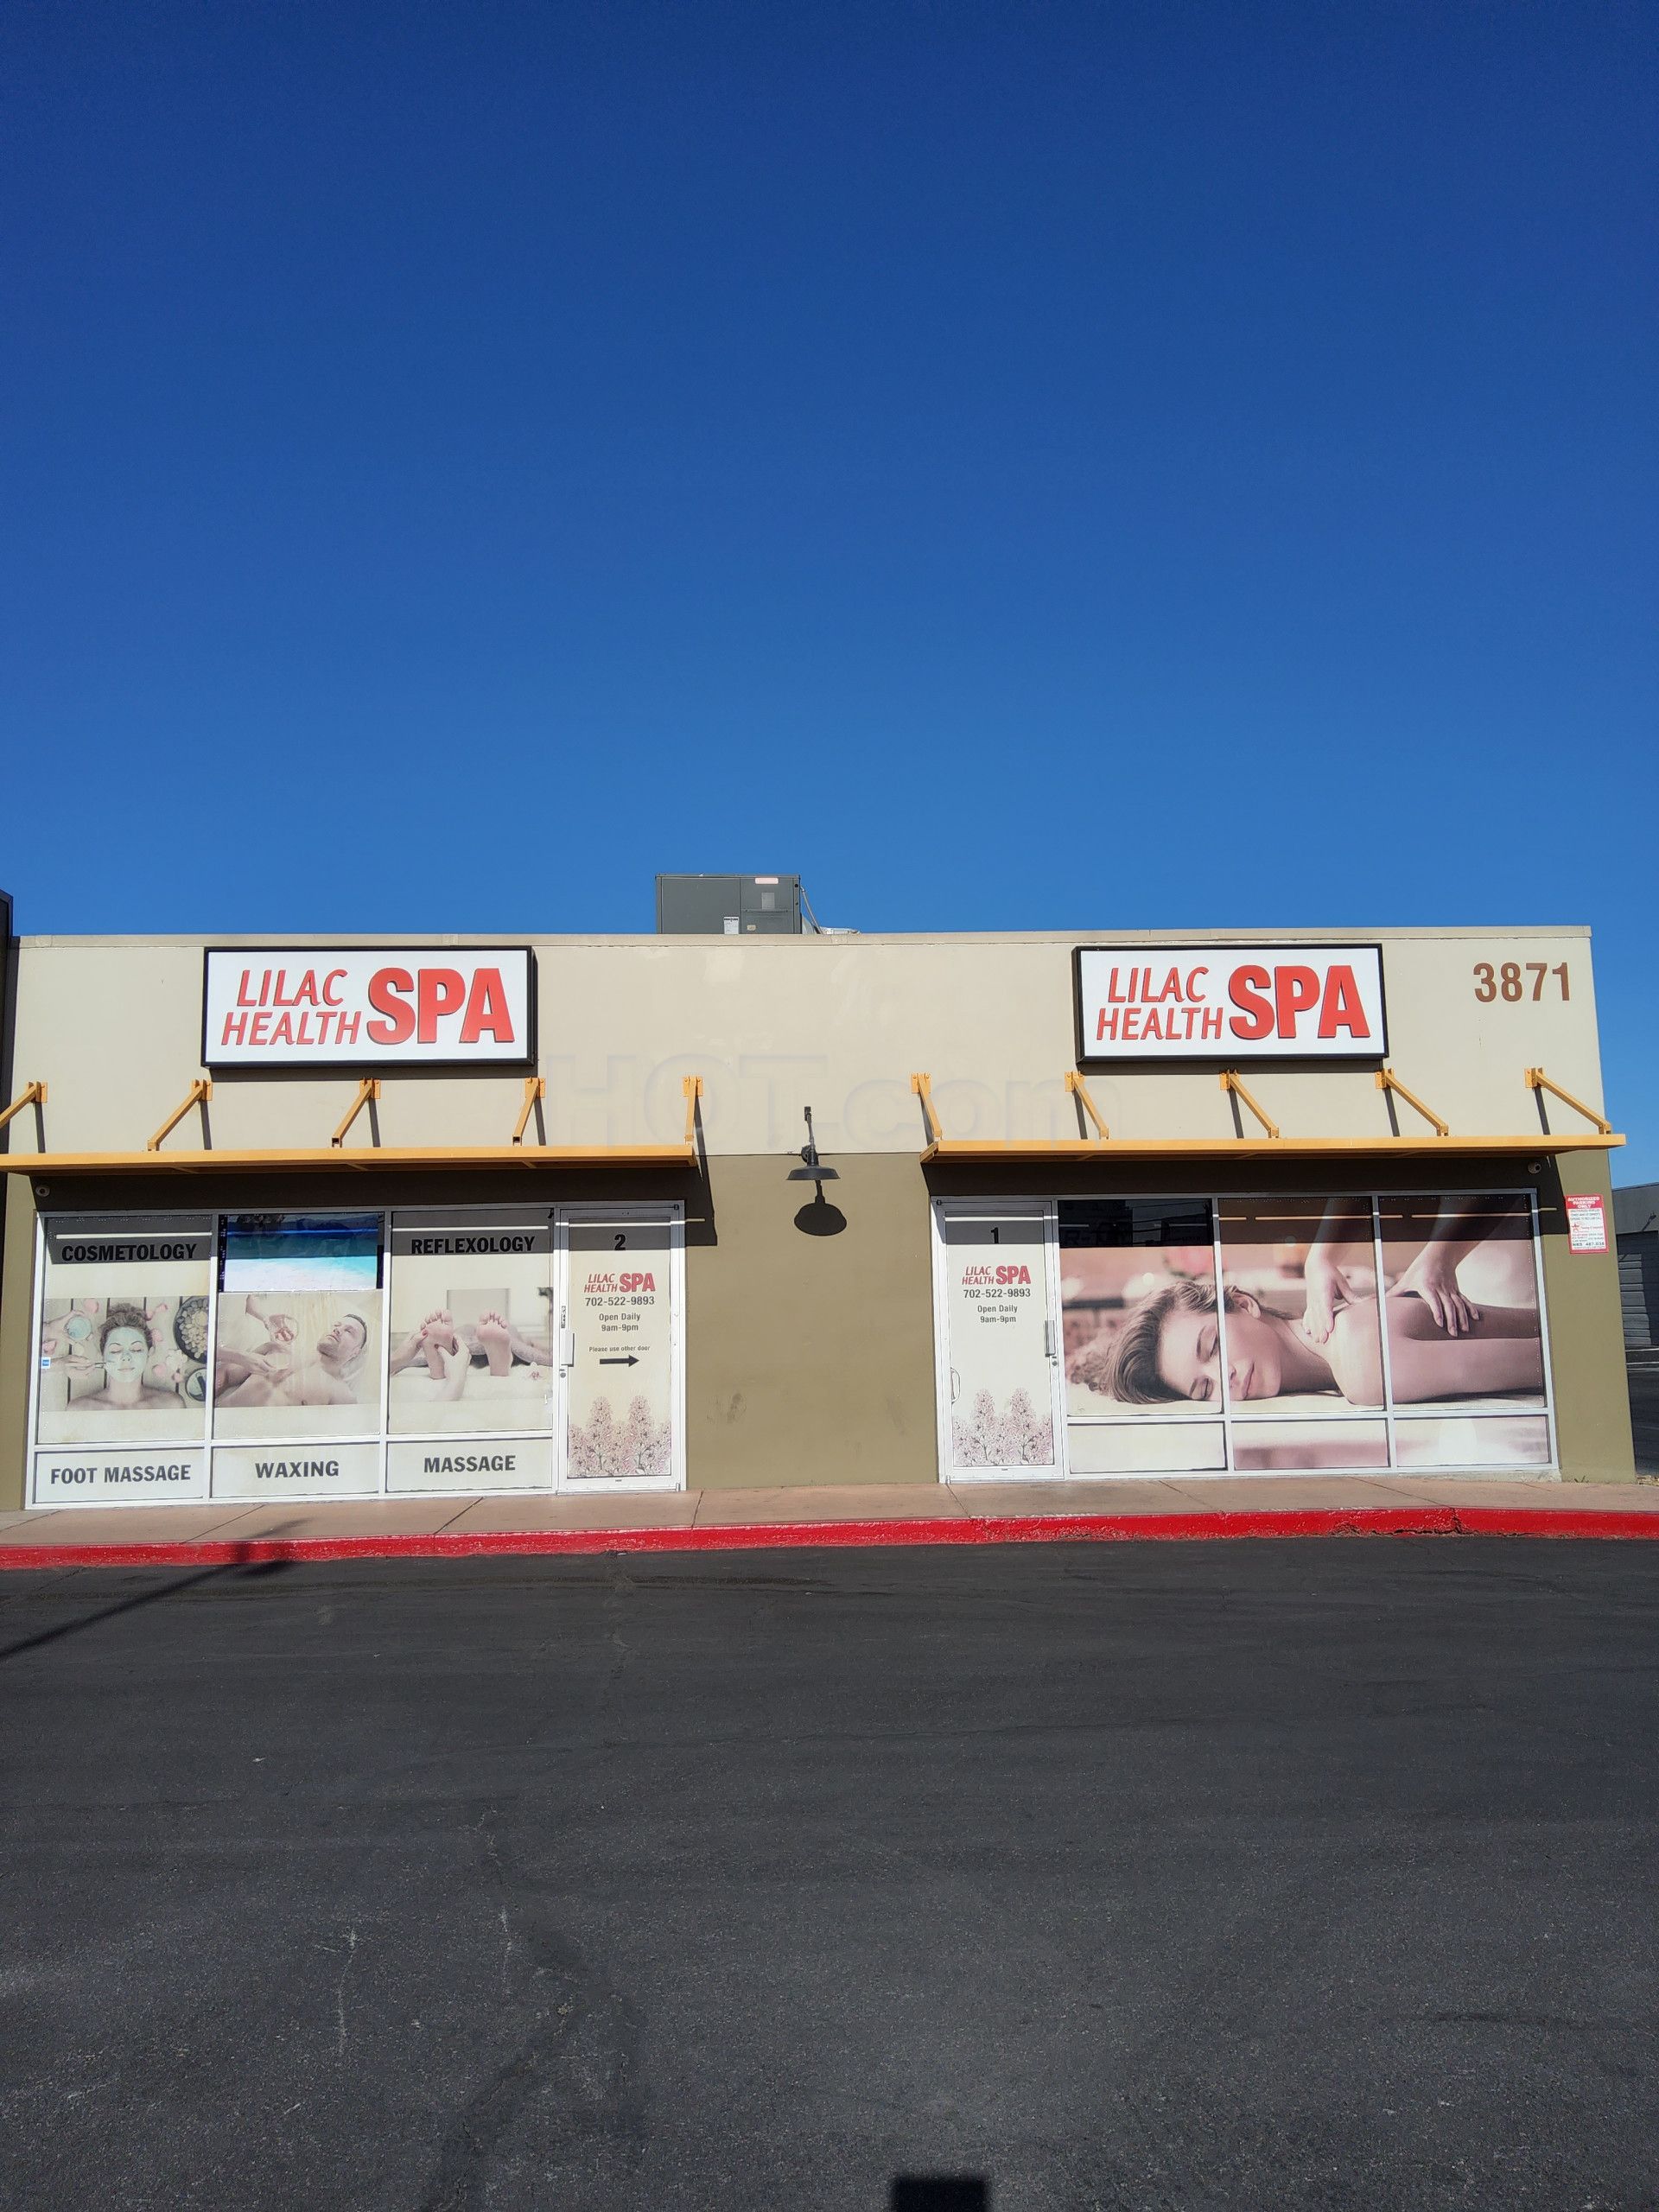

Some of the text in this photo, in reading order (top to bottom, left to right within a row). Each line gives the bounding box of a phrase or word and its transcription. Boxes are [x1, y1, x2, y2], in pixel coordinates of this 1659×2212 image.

[237, 969, 347, 1007] LILAC
[1108, 966, 1209, 1003] LILAC
[1473, 962, 1571, 1002] 3871
[367, 967, 515, 1044] SPA
[1229, 964, 1370, 1039] SPA
[221, 1011, 362, 1046] HEALTH
[1096, 1007, 1224, 1040] HEALTH
[613, 1234, 626, 1251] 2
[990, 1227, 1000, 1244] 1
[61, 1243, 198, 1262] COSMETOLOGY
[410, 1236, 535, 1255] REFLEXOLOGY
[588, 1273, 615, 1283] LILAC
[962, 1275, 995, 1285] HEALTH
[965, 1266, 992, 1276] LILAC
[995, 1265, 1032, 1285] SPA
[583, 1283, 618, 1294] HEALTH
[619, 1272, 656, 1293] SPA
[584, 1296, 655, 1306] 702-522-9893
[963, 1288, 1031, 1299] 702-522-9893
[599, 1313, 641, 1322] Open Daily
[977, 1305, 1018, 1313] Open Daily
[980, 1315, 1016, 1324] 9am-9pm
[255, 1460, 340, 1478] WAXING
[423, 1455, 516, 1473] MASSAGE
[50, 1465, 191, 1484] FOOT MASSAGE
